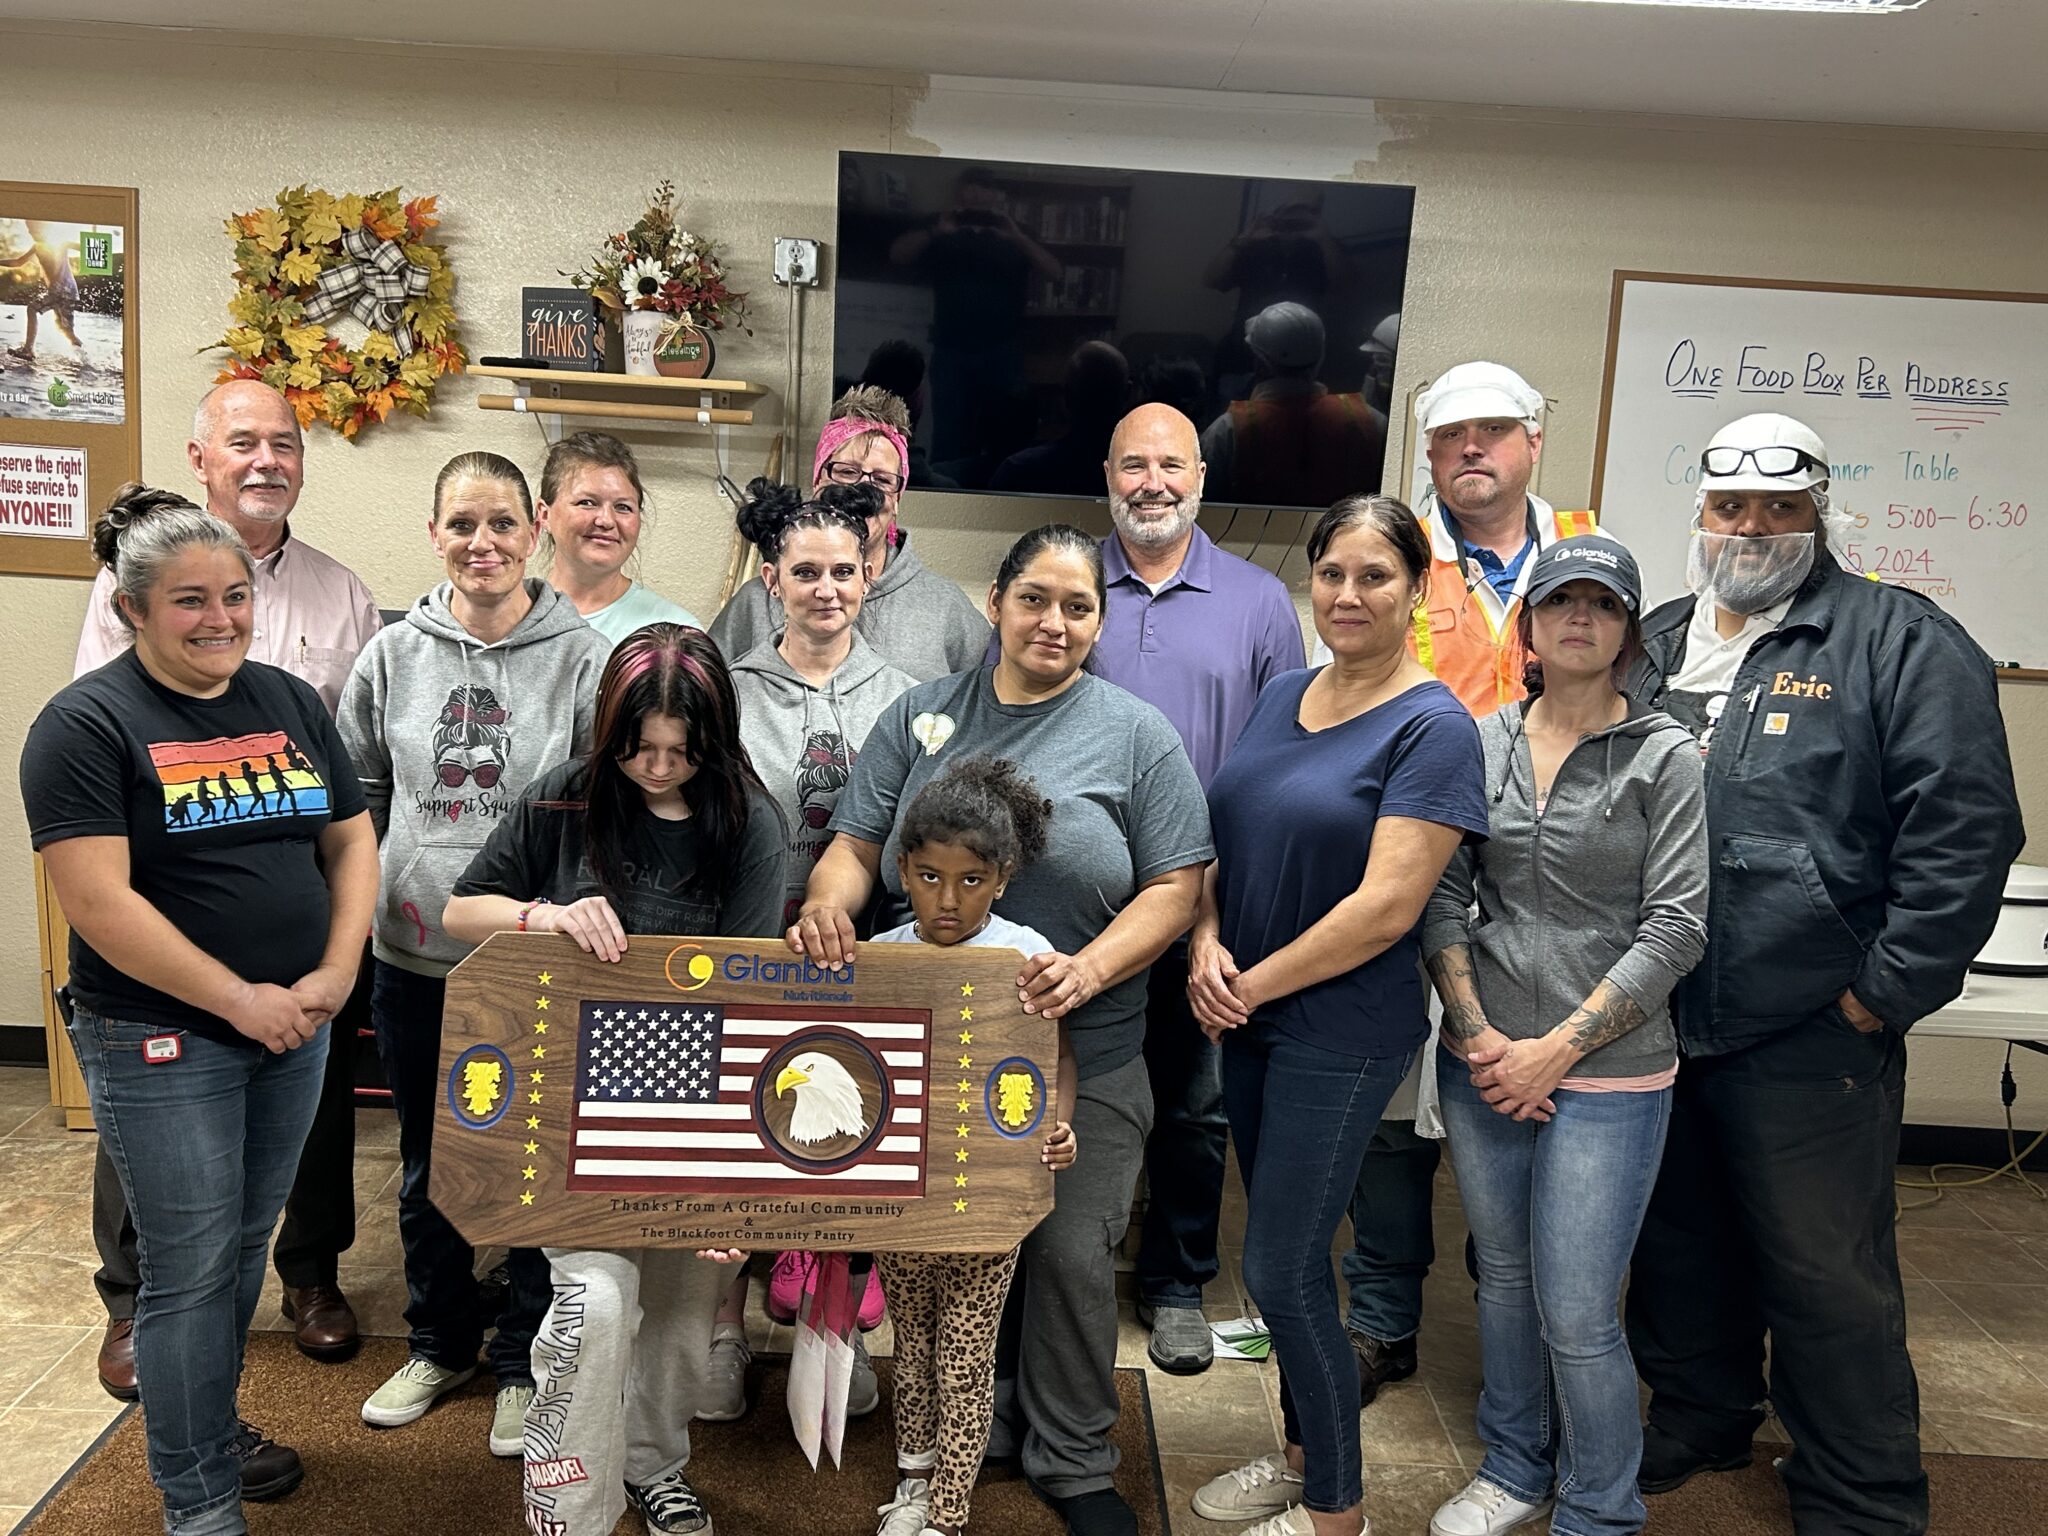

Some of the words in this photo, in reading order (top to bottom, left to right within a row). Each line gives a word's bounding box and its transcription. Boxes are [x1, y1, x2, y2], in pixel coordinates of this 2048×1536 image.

[86, 247, 105, 261] LIVE
[527, 304, 588, 336] give
[527, 323, 587, 359] THANKS
[1666, 339, 1724, 388] ONE
[1737, 346, 1794, 388] FOOD
[1857, 357, 1890, 391] PER
[1905, 361, 2010, 397] ADDRESS
[67, 391, 91, 404] Smart
[93, 391, 114, 406] Idaho
[0, 457, 32, 473] serve
[36, 455, 53, 474] the
[56, 456, 82, 480] right
[1829, 463, 1874, 481] nner
[1898, 450, 1959, 483] Table
[0, 474, 23, 495] fuse
[26, 477, 65, 497] service
[68, 480, 78, 498] to
[0, 499, 72, 528] NYONE!!!
[1968, 495, 2028, 530] 6:30
[1572, 547, 1617, 563] Glanbia
[1875, 546, 1935, 574] 2024
[1770, 671, 1833, 700] Eric
[478, 791, 513, 818] Squ
[627, 911, 652, 926] BEER
[654, 919, 681, 933] WILL
[656, 905, 681, 919] DIRT
[610, 1199, 669, 1212] Thanks
[675, 1200, 715, 1213] From
[723, 1201, 734, 1213] A
[739, 1200, 805, 1214] Grateful
[811, 1201, 905, 1217] Community
[641, 1227, 664, 1238] The
[668, 1228, 730, 1239] Blackfoot
[735, 1229, 809, 1241] Community
[815, 1229, 855, 1242] Pantry
[744, 1217, 754, 1227] &
[528, 1458, 586, 1488] MARVEL
